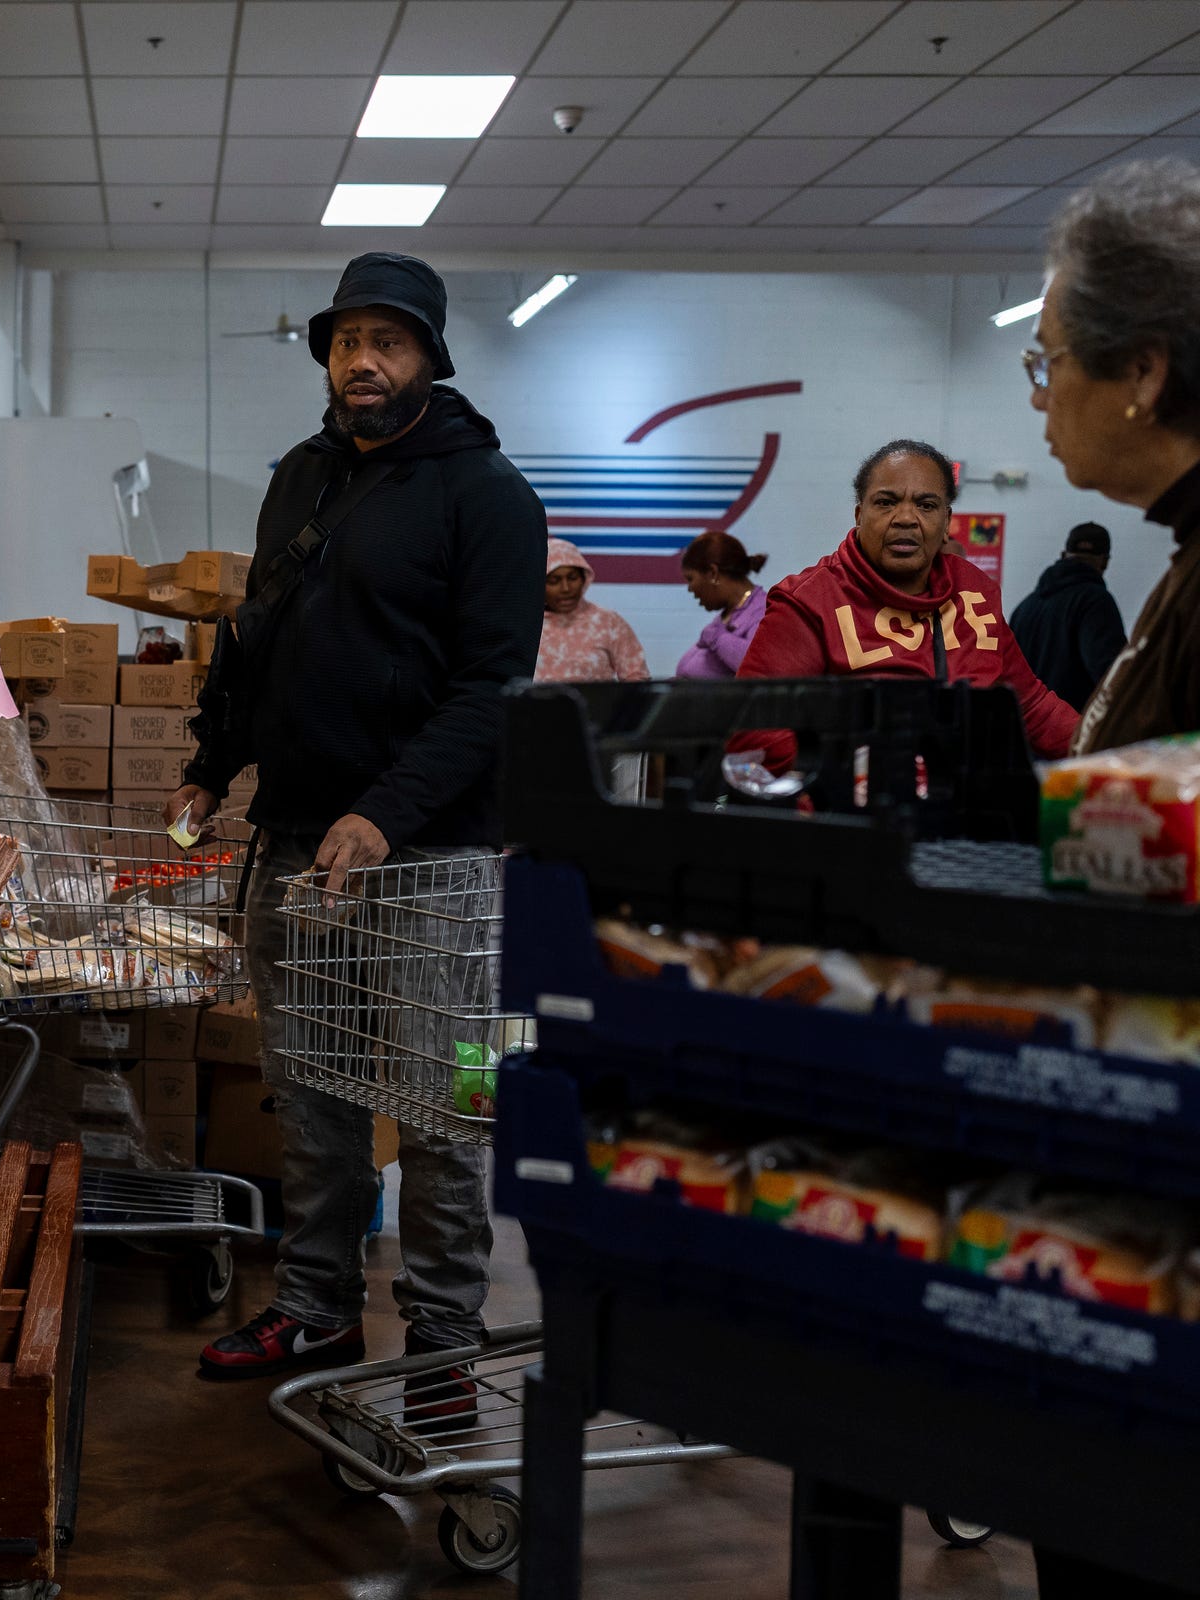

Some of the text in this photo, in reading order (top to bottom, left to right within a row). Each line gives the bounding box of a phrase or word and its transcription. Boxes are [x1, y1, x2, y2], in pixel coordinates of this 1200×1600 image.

[834, 590, 999, 671] LOVE
[138, 674, 175, 686] INSPIRED
[140, 687, 173, 698] FLAVOR
[130, 716, 166, 728] INSPIRED
[132, 729, 165, 741] FLAVOR
[127, 759, 165, 770] INSPIRED
[129, 772, 162, 783] FLAVOR
